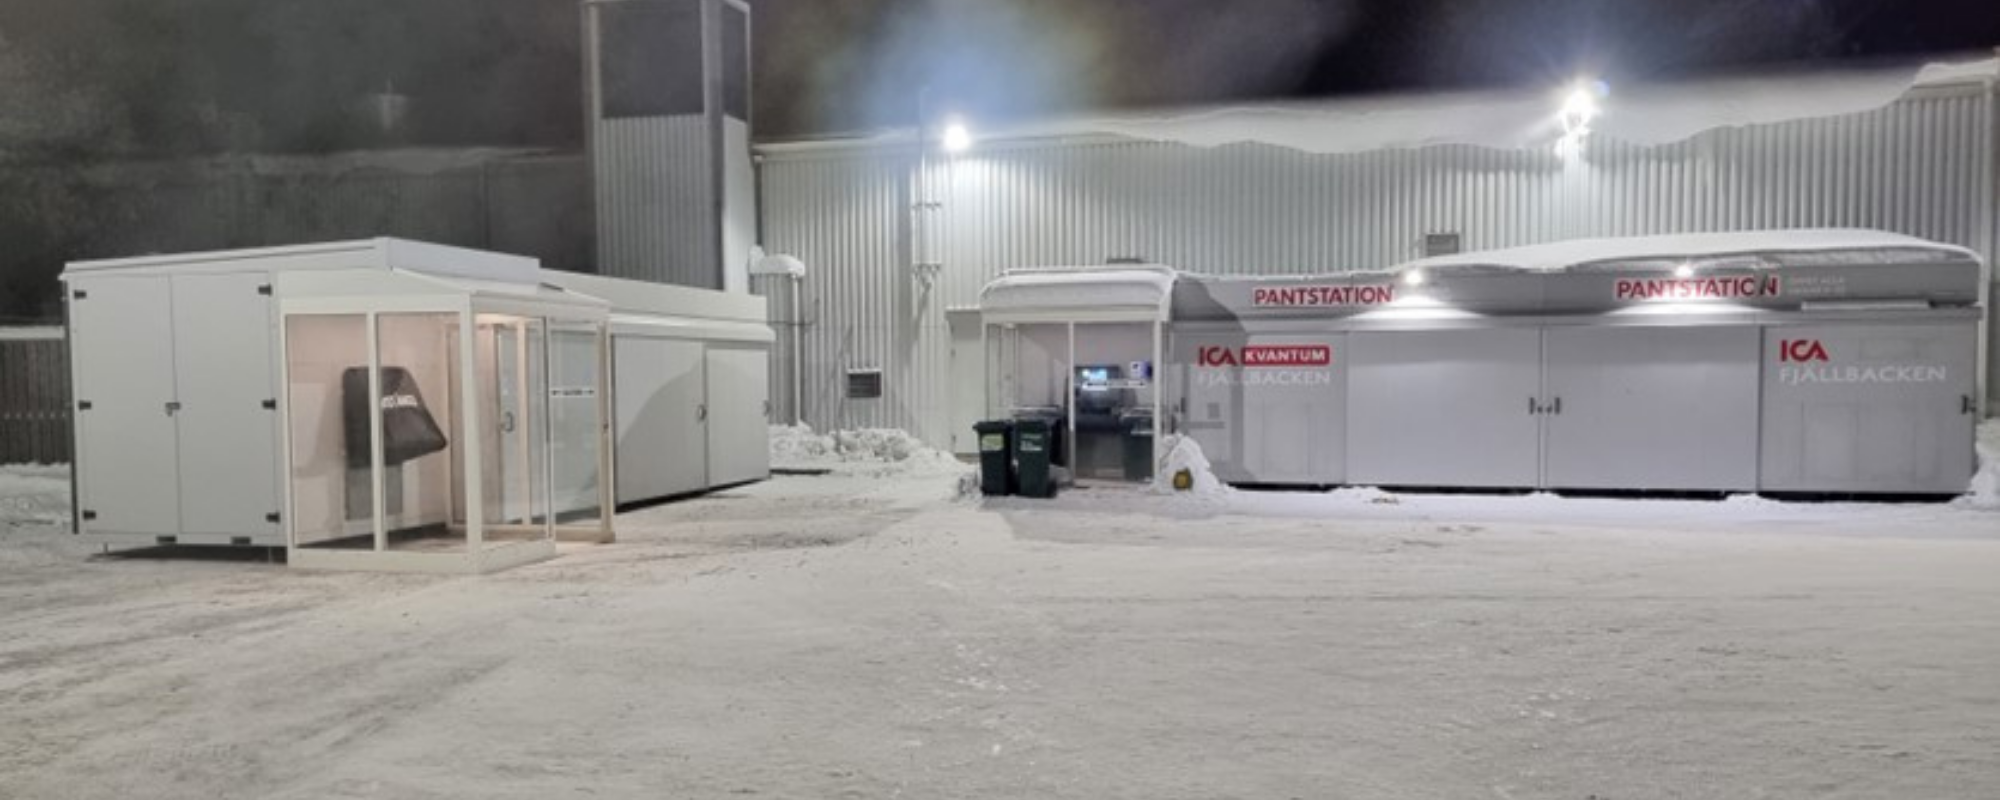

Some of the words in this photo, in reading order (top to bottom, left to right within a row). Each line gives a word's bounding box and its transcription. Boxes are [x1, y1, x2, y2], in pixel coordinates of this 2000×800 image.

[1254, 286, 1391, 305] PANTSTATION
[1616, 277, 1779, 299] PANTSTATION
[1198, 347, 1238, 366] ICA
[1244, 348, 1326, 361] KVANTUM
[1780, 340, 1829, 362] ICA
[1197, 368, 1331, 388] FJÄBACKEN
[1778, 363, 1947, 385] FJÄLLBACKEN
